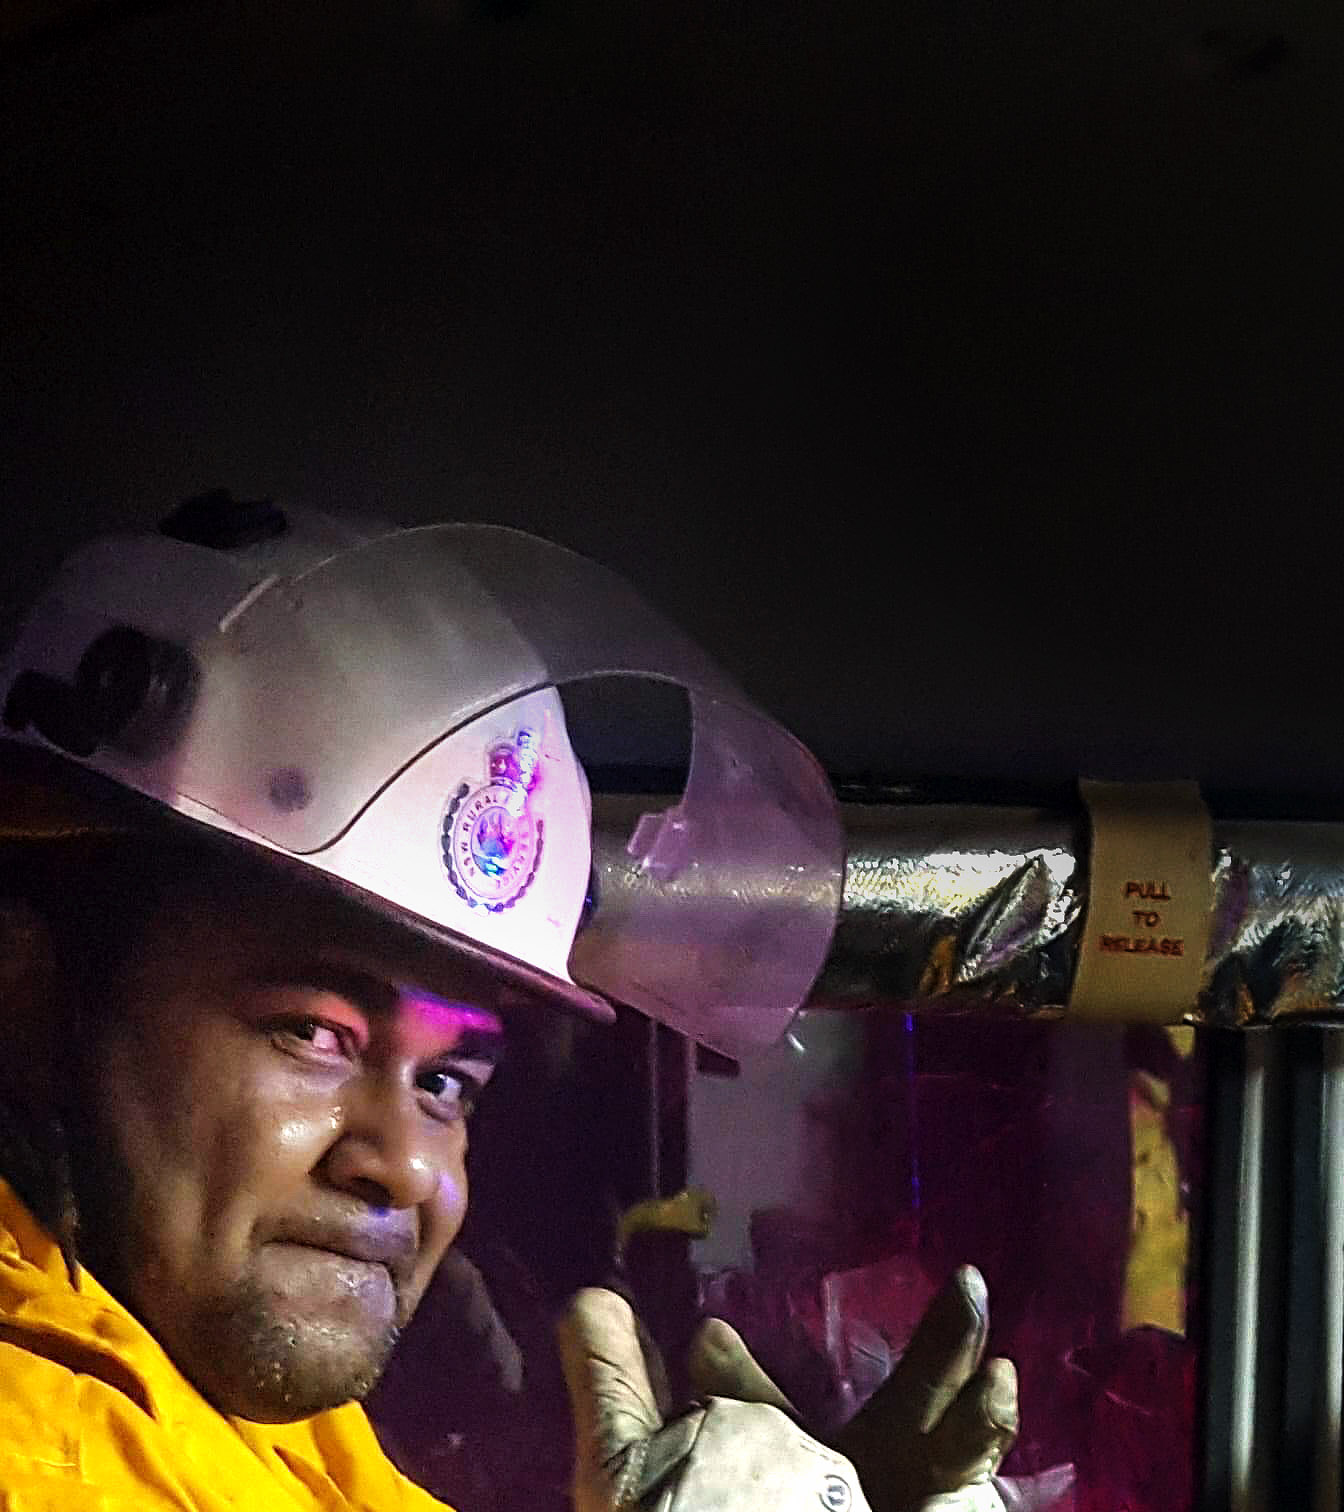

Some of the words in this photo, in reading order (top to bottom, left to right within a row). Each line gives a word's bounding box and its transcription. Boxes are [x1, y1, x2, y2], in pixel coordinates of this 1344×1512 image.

[1124, 881, 1171, 901] PULL
[1132, 909, 1161, 927] TO
[1098, 934, 1185, 957] RELEASE
